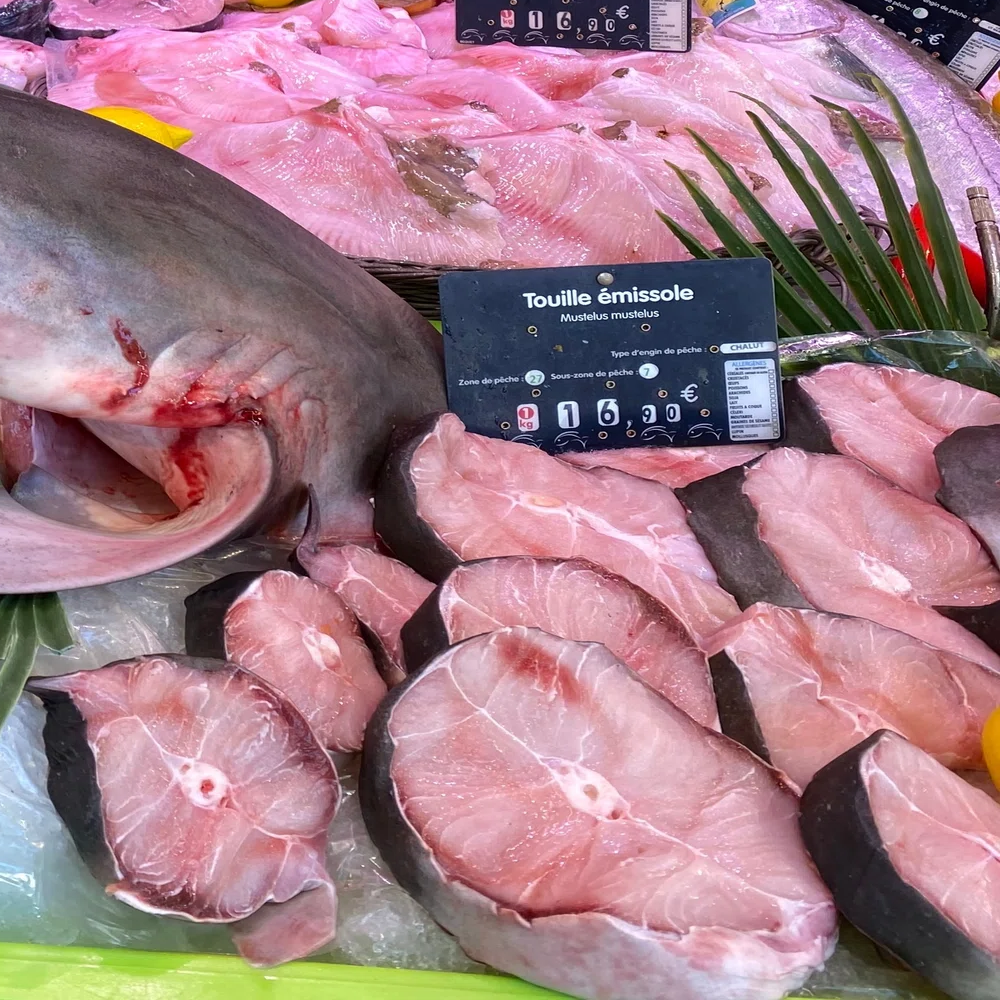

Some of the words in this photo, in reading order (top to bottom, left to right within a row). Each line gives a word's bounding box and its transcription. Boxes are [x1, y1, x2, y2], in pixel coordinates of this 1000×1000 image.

[616, 5, 629, 19] €
[928, 34, 945, 45] €
[522, 289, 592, 308] Touille
[597, 284, 694, 304] émissole
[560, 311, 609, 322] Mustelus
[611, 309, 660, 320] mustelus
[632, 349, 662, 357] d'engin
[677, 347, 702, 355] pêche
[730, 342, 764, 351] CHALUT
[495, 376, 519, 385] pêche
[529, 375, 543, 383] 27
[551, 372, 594, 380] Sous-zone
[609, 369, 634, 379] pêche
[644, 368, 650, 376] 7
[680, 383, 698, 402] €
[557, 398, 681, 429] 16,90
[520, 420, 532, 429] kg
